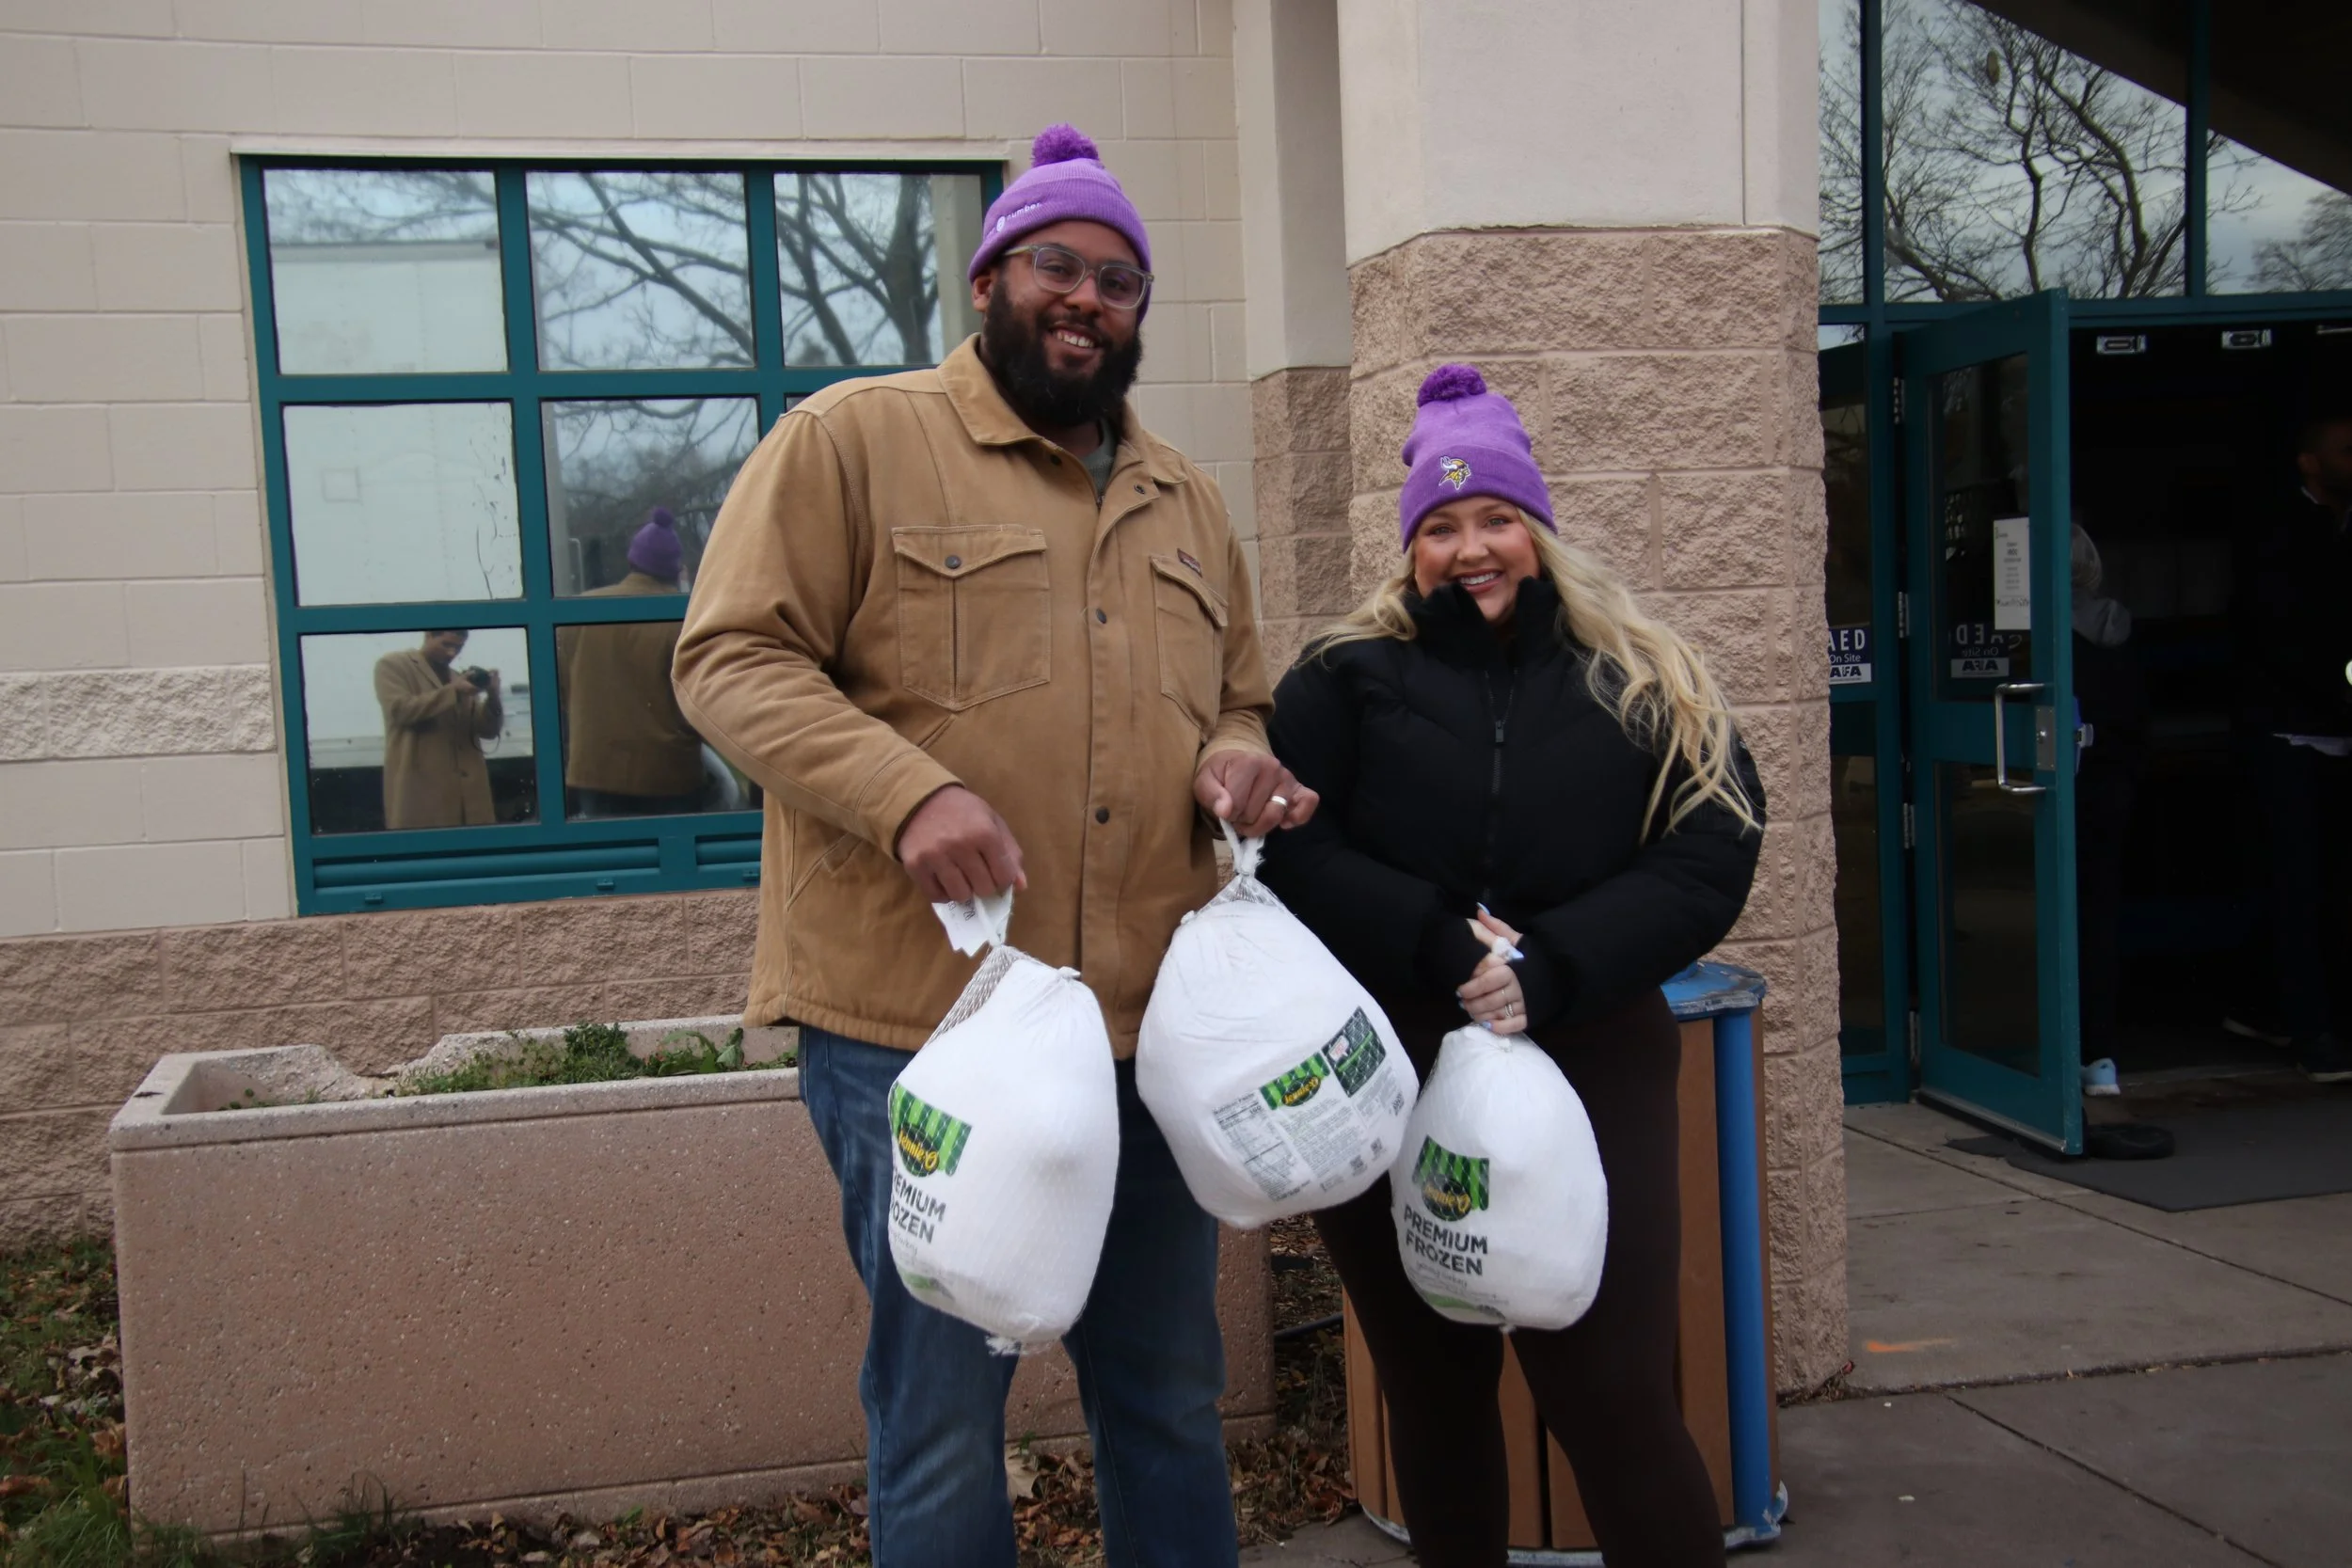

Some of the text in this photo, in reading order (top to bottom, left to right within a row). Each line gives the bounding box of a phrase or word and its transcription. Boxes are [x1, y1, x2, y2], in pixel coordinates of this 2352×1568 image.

[1829, 653, 1862, 663] On Site
[890, 1195, 935, 1243] OZEN
[894, 1169, 946, 1222] EMIUM
[1404, 1204, 1488, 1255] PREMIUM
[1405, 1229, 1483, 1276] FROZEN
